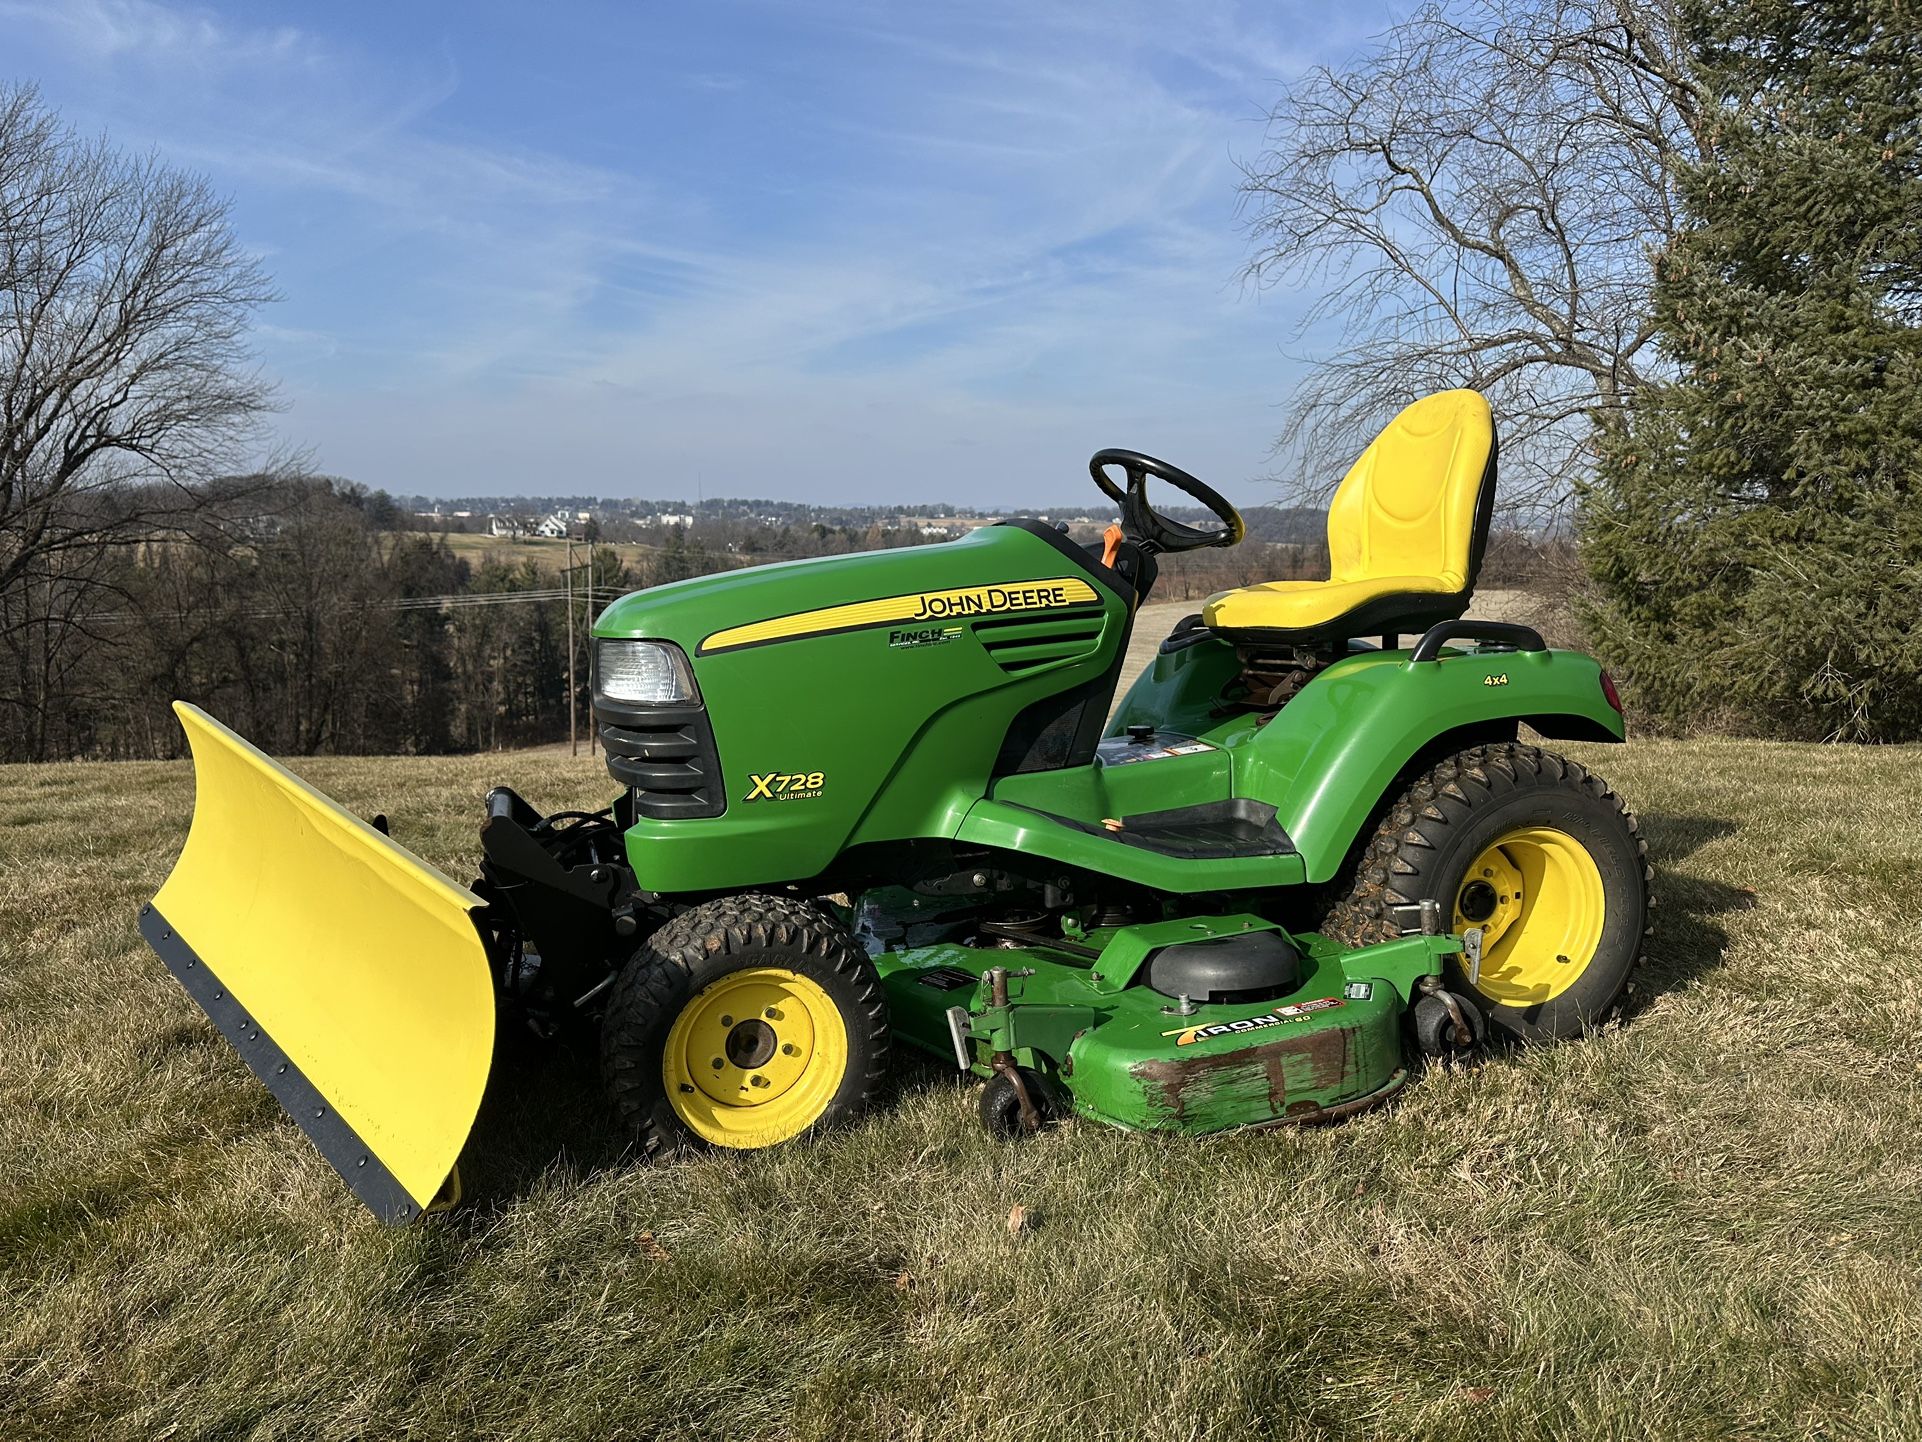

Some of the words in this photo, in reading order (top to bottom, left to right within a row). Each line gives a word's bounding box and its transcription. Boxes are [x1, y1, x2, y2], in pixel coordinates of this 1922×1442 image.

[913, 594, 984, 618] JOHN
[987, 587, 1067, 609] DEERE
[889, 628, 943, 644] FINCH
[1484, 673, 1508, 686] 4x4
[743, 771, 825, 801] X728
[779, 790, 823, 801] Ultimate
[1234, 1019, 1293, 1034] COMMERCIAL
